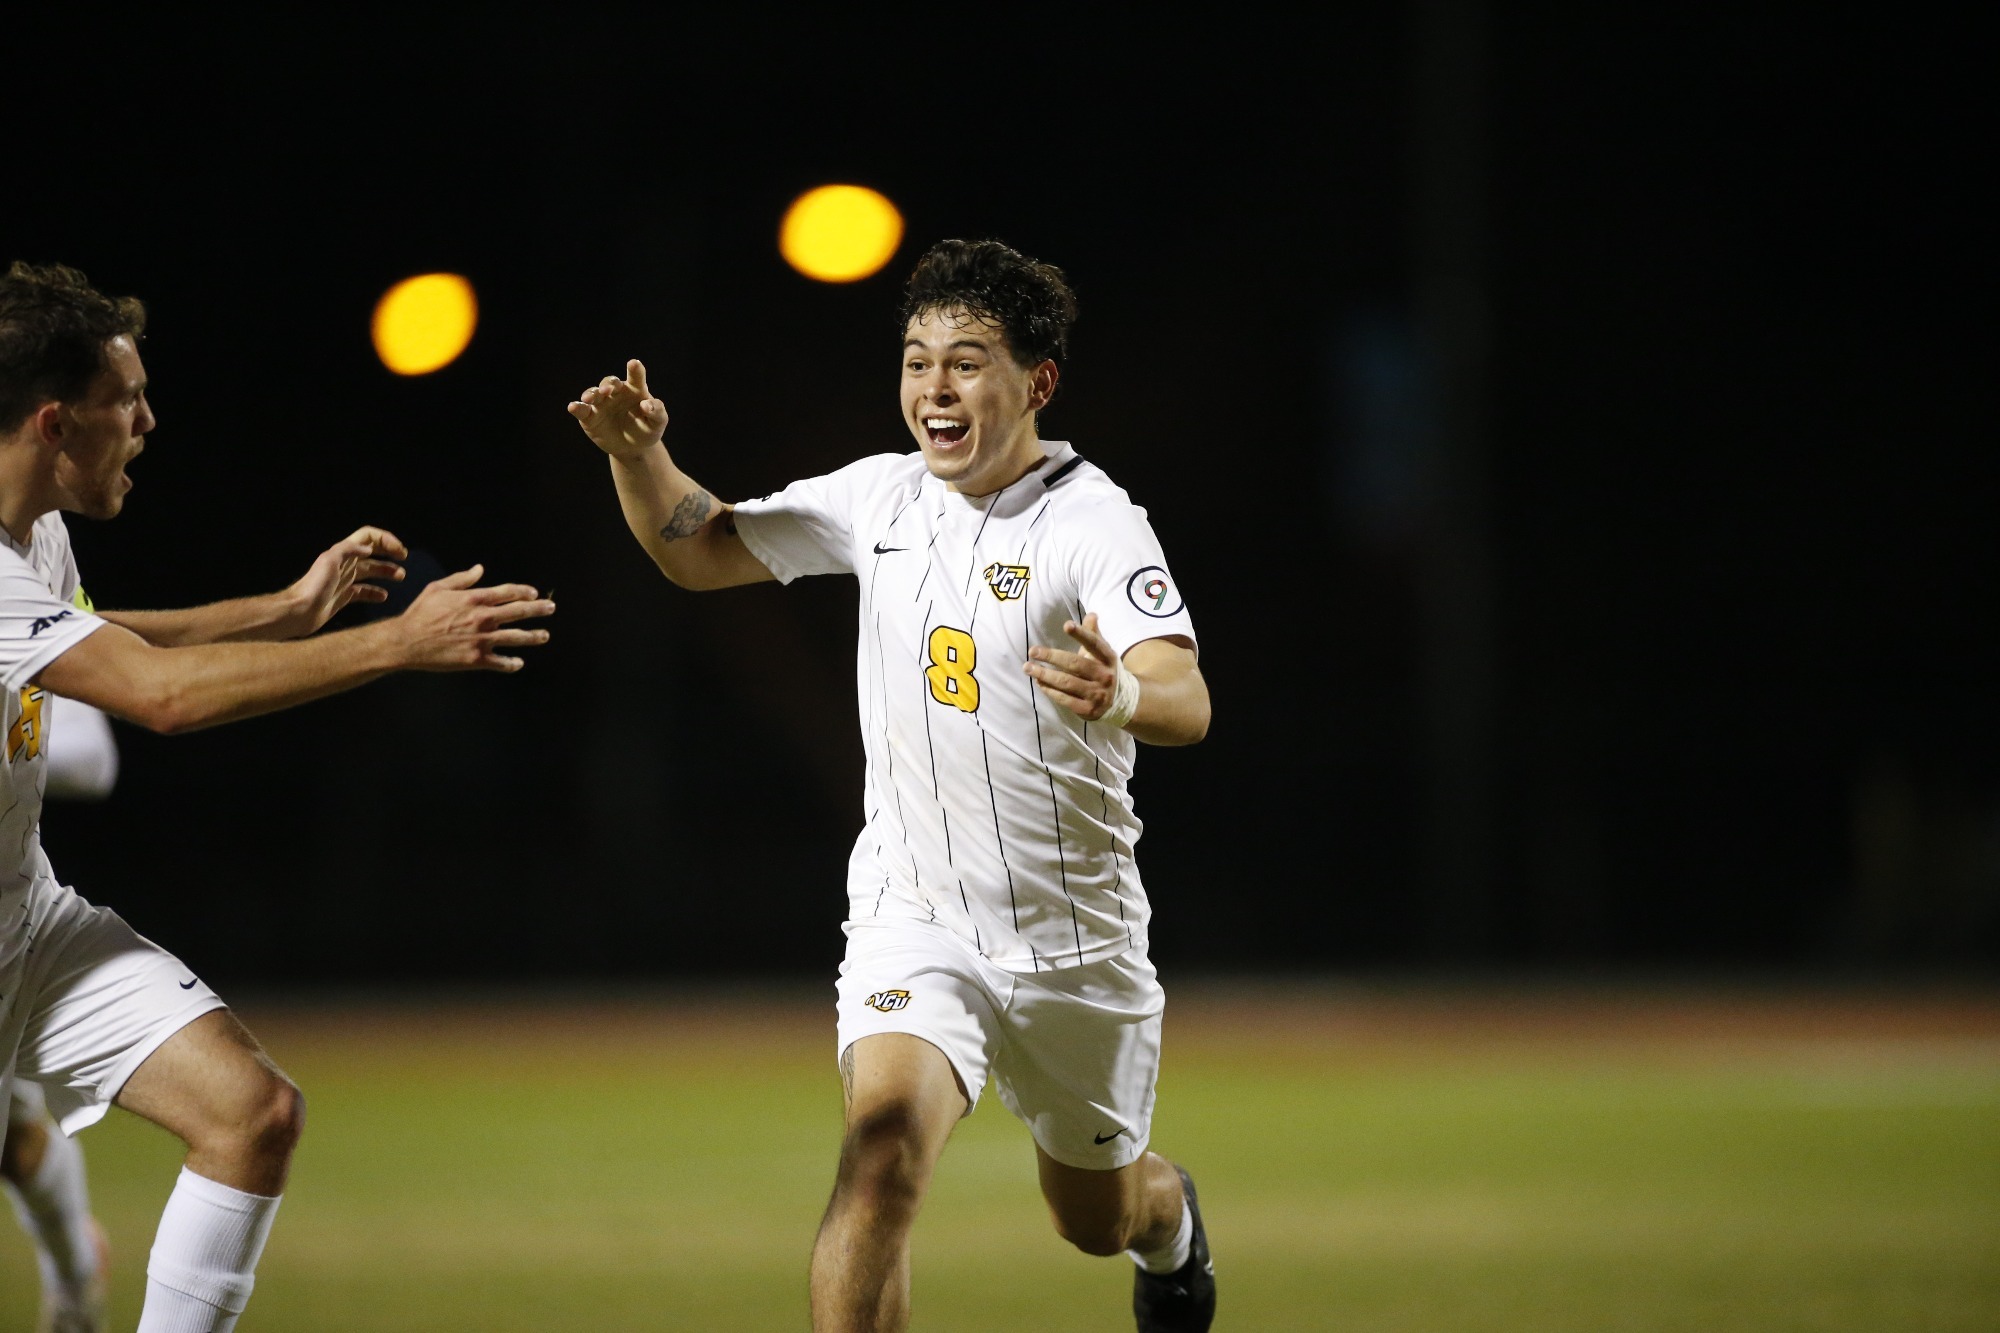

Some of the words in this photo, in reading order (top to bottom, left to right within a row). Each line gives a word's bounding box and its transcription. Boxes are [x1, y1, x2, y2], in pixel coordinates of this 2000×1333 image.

[983, 562, 1030, 600] VCU
[1144, 579, 1168, 611] 9
[925, 625, 980, 713] 8
[864, 990, 911, 1012] VCU
